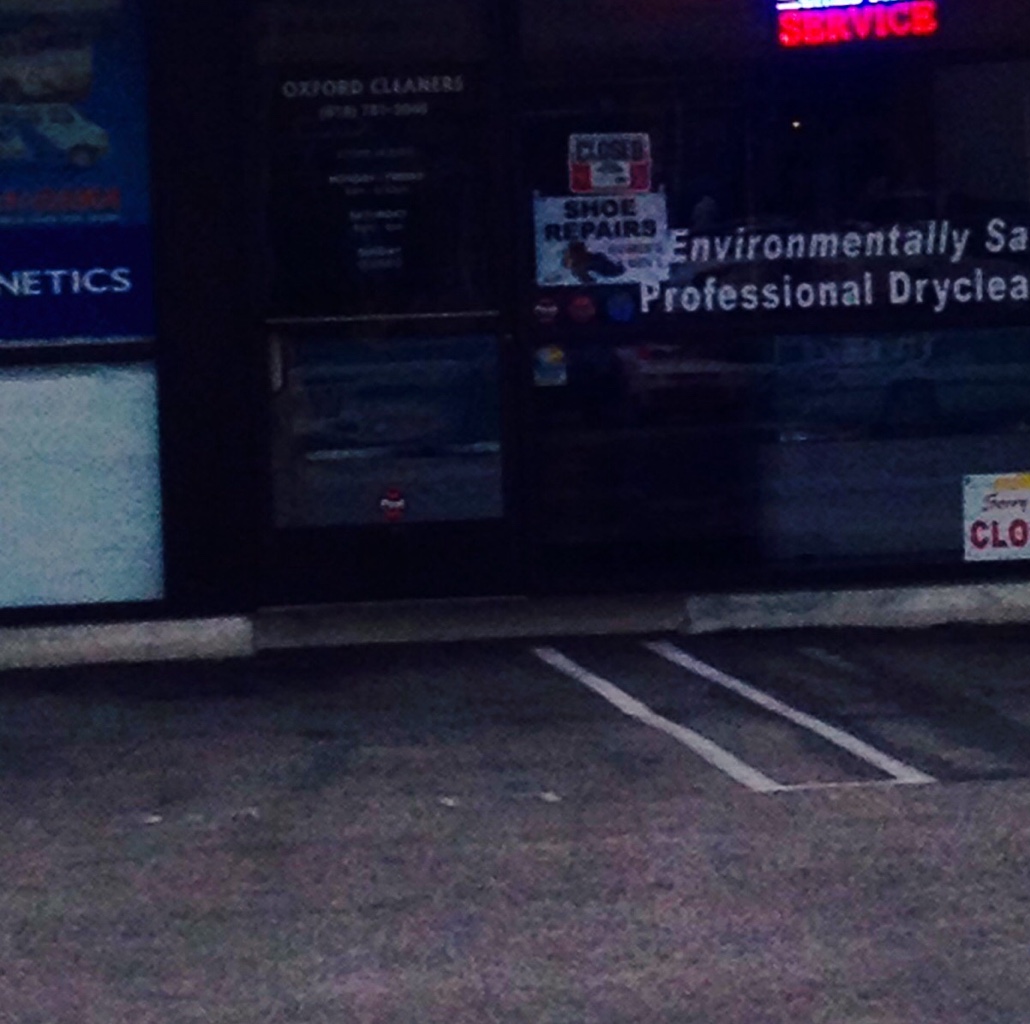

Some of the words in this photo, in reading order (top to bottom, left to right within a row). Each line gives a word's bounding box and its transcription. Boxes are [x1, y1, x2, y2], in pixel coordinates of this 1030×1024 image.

[779, 0, 938, 47] SERVICE
[281, 79, 364, 97] OXFORD
[370, 75, 464, 94] CLEANERS
[564, 199, 637, 219] SHOE
[544, 219, 657, 242] REPAIRS
[668, 220, 970, 264] Environmentally
[641, 272, 873, 313] Professional
